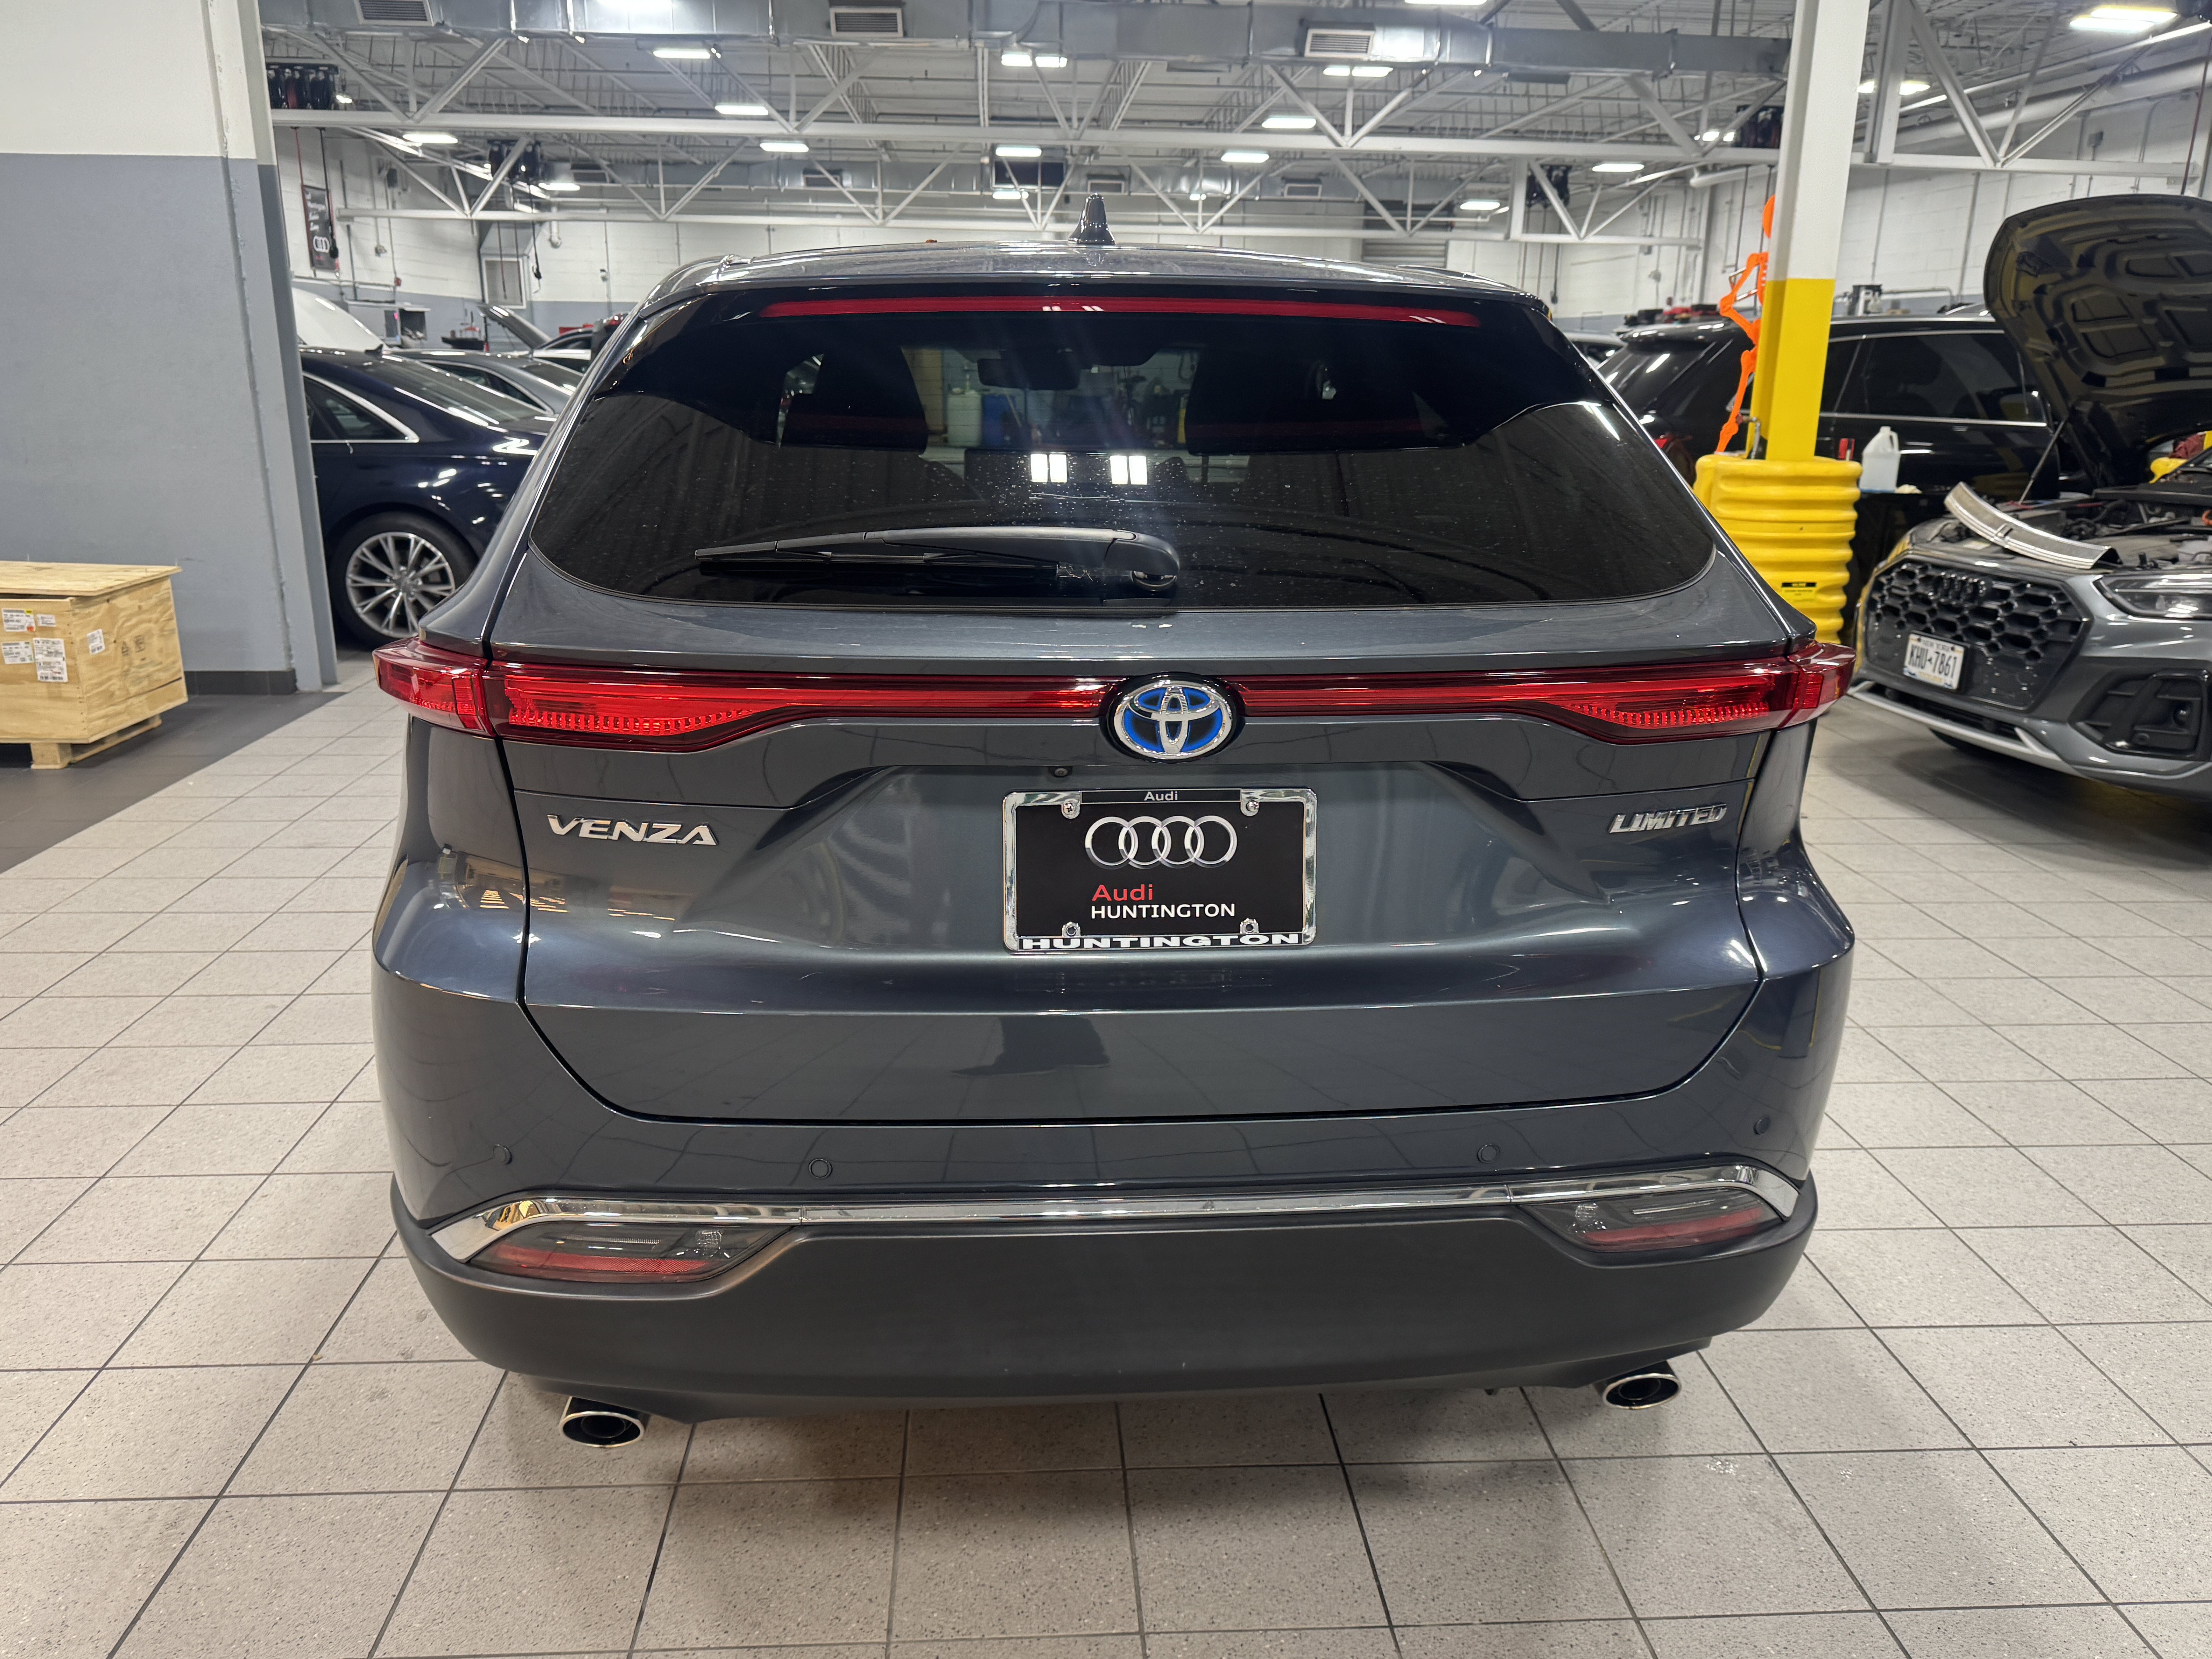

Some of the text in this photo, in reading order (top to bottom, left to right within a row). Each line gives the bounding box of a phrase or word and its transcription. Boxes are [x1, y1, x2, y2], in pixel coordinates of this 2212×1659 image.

[1144, 791, 1178, 802] Audi
[1609, 803, 1727, 833] LIMITED
[547, 814, 719, 846] VENZA
[1092, 884, 1153, 902] Audi
[1091, 903, 1235, 919] HUNTINGTON
[1022, 933, 1301, 950] HUNTINGTON
